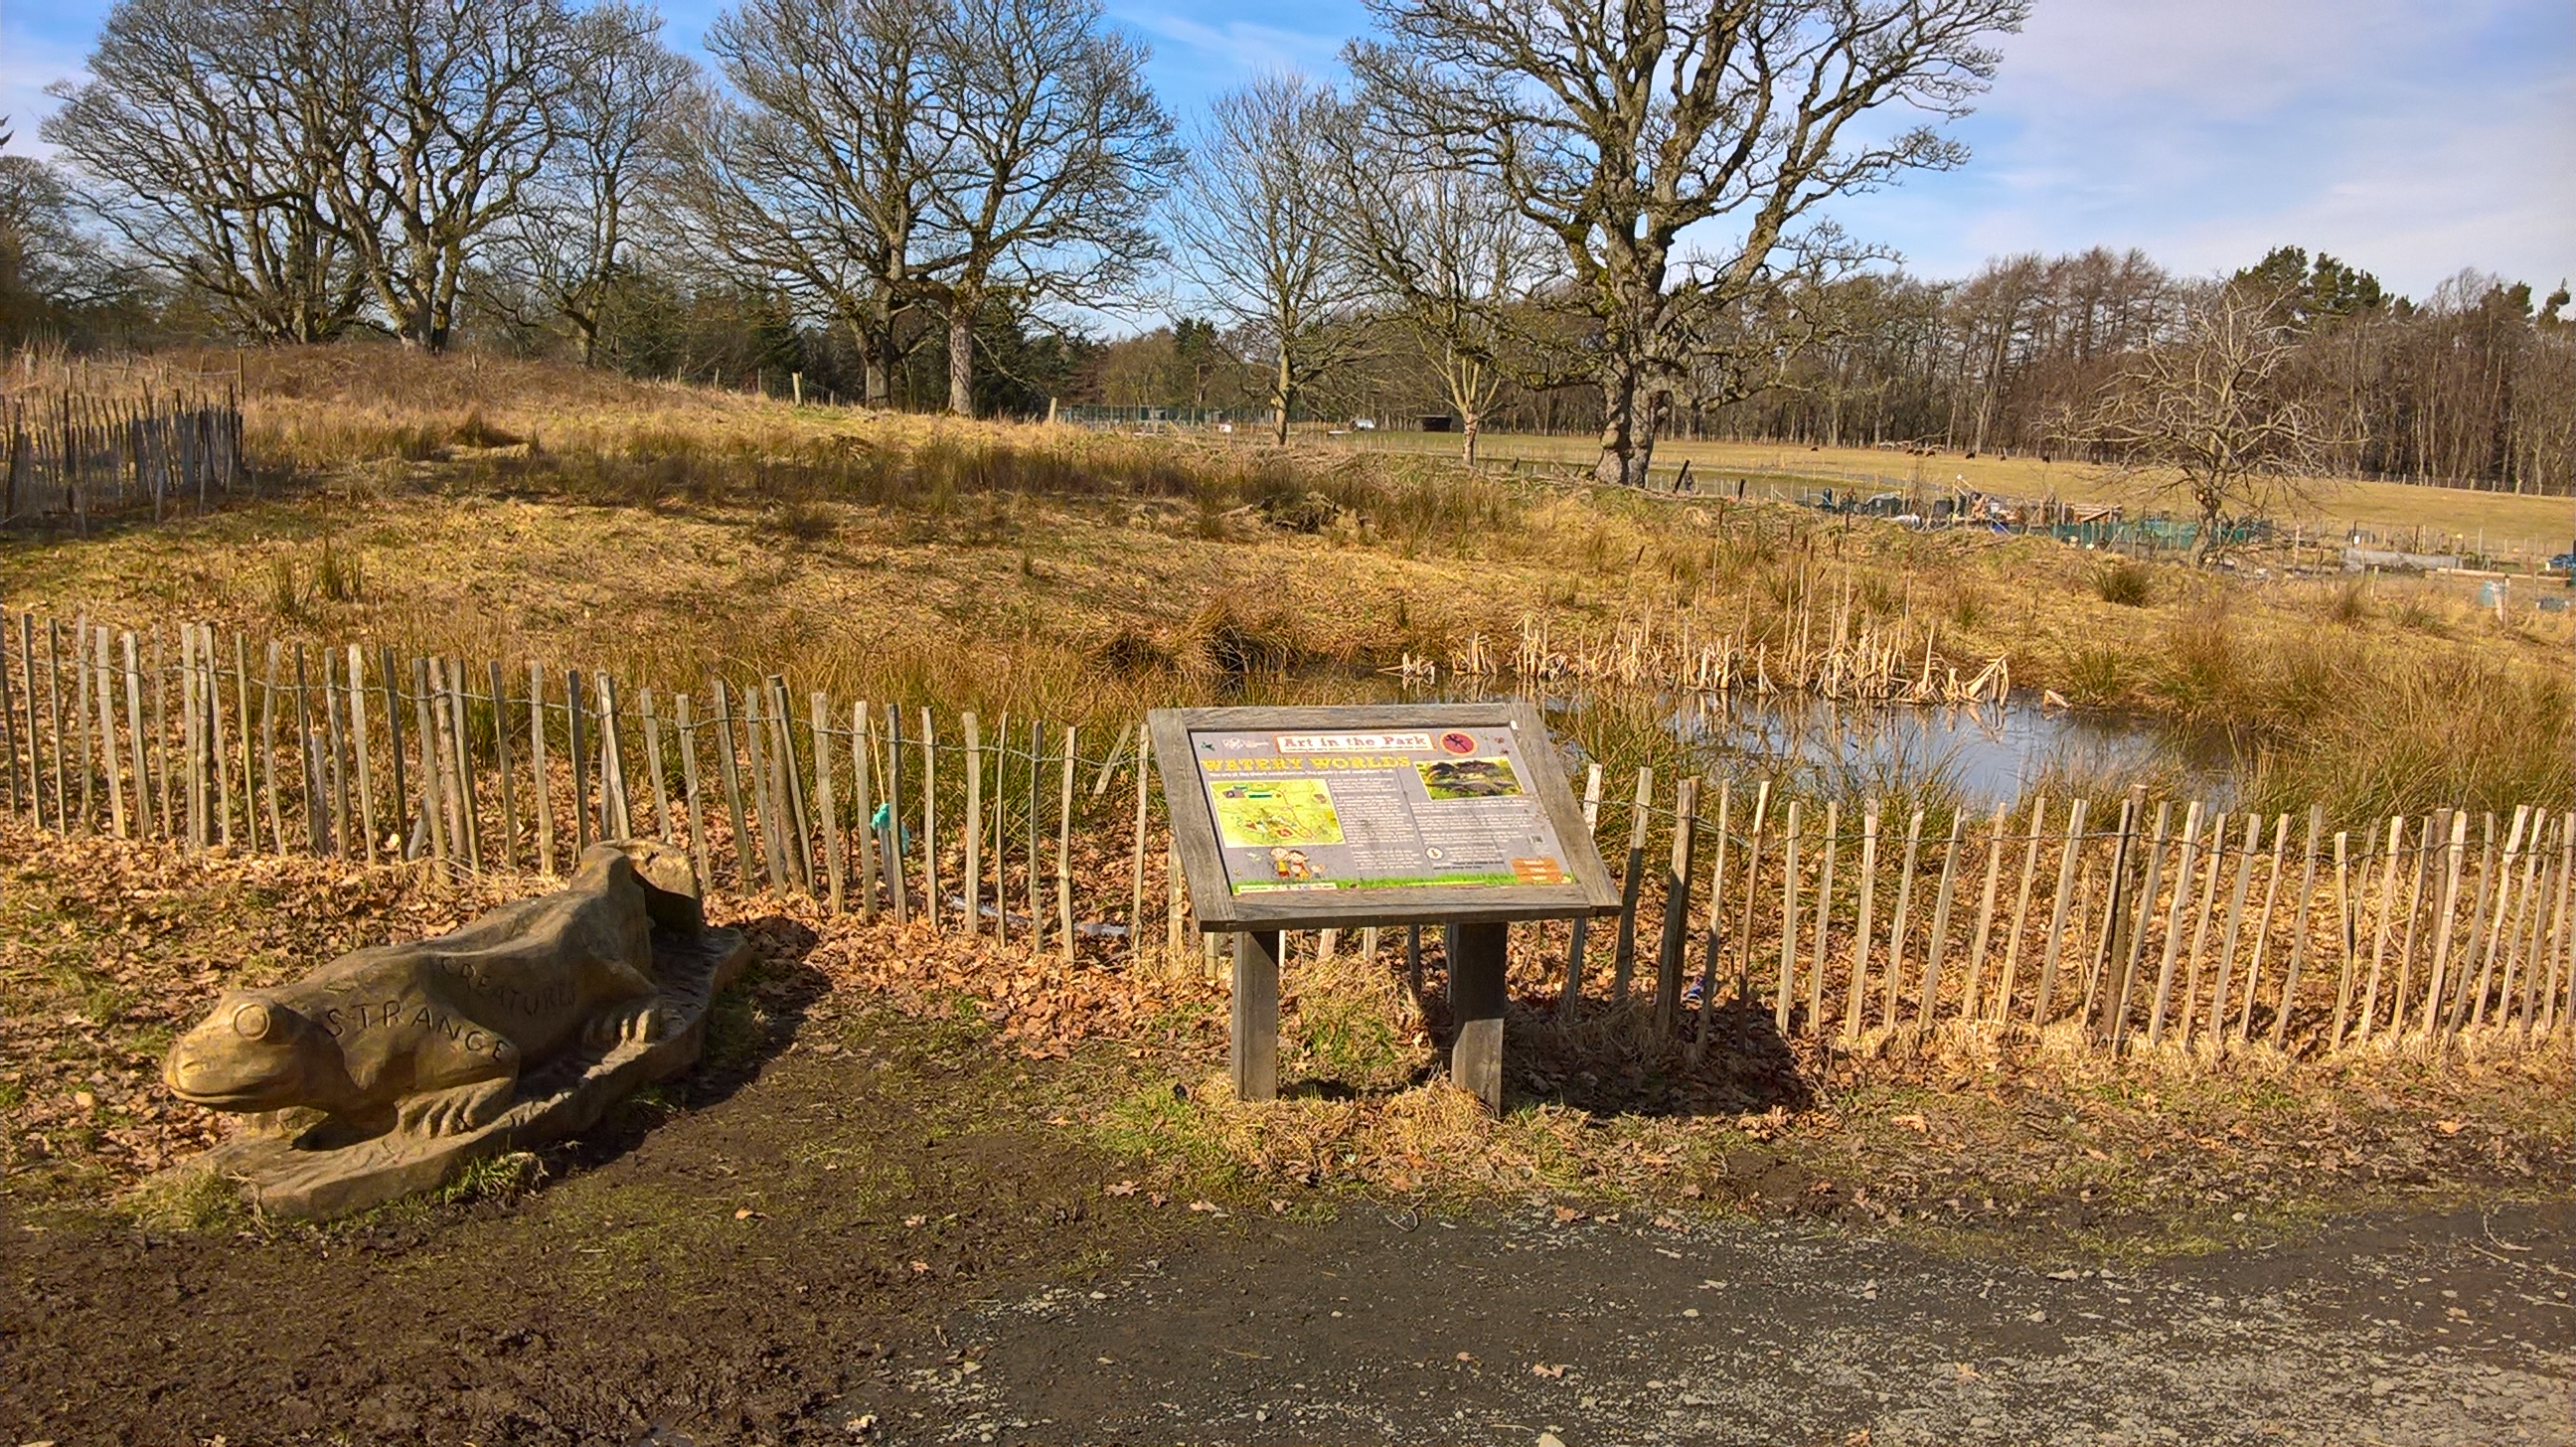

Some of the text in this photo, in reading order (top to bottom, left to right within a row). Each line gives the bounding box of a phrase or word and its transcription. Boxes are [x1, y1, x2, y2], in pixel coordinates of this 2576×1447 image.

[1284, 735, 1427, 747] Art in the Park
[1201, 755, 1411, 771] WATERY WORLDS
[440, 956, 577, 1018] CREATURES
[324, 1000, 511, 1062] STRANGE
